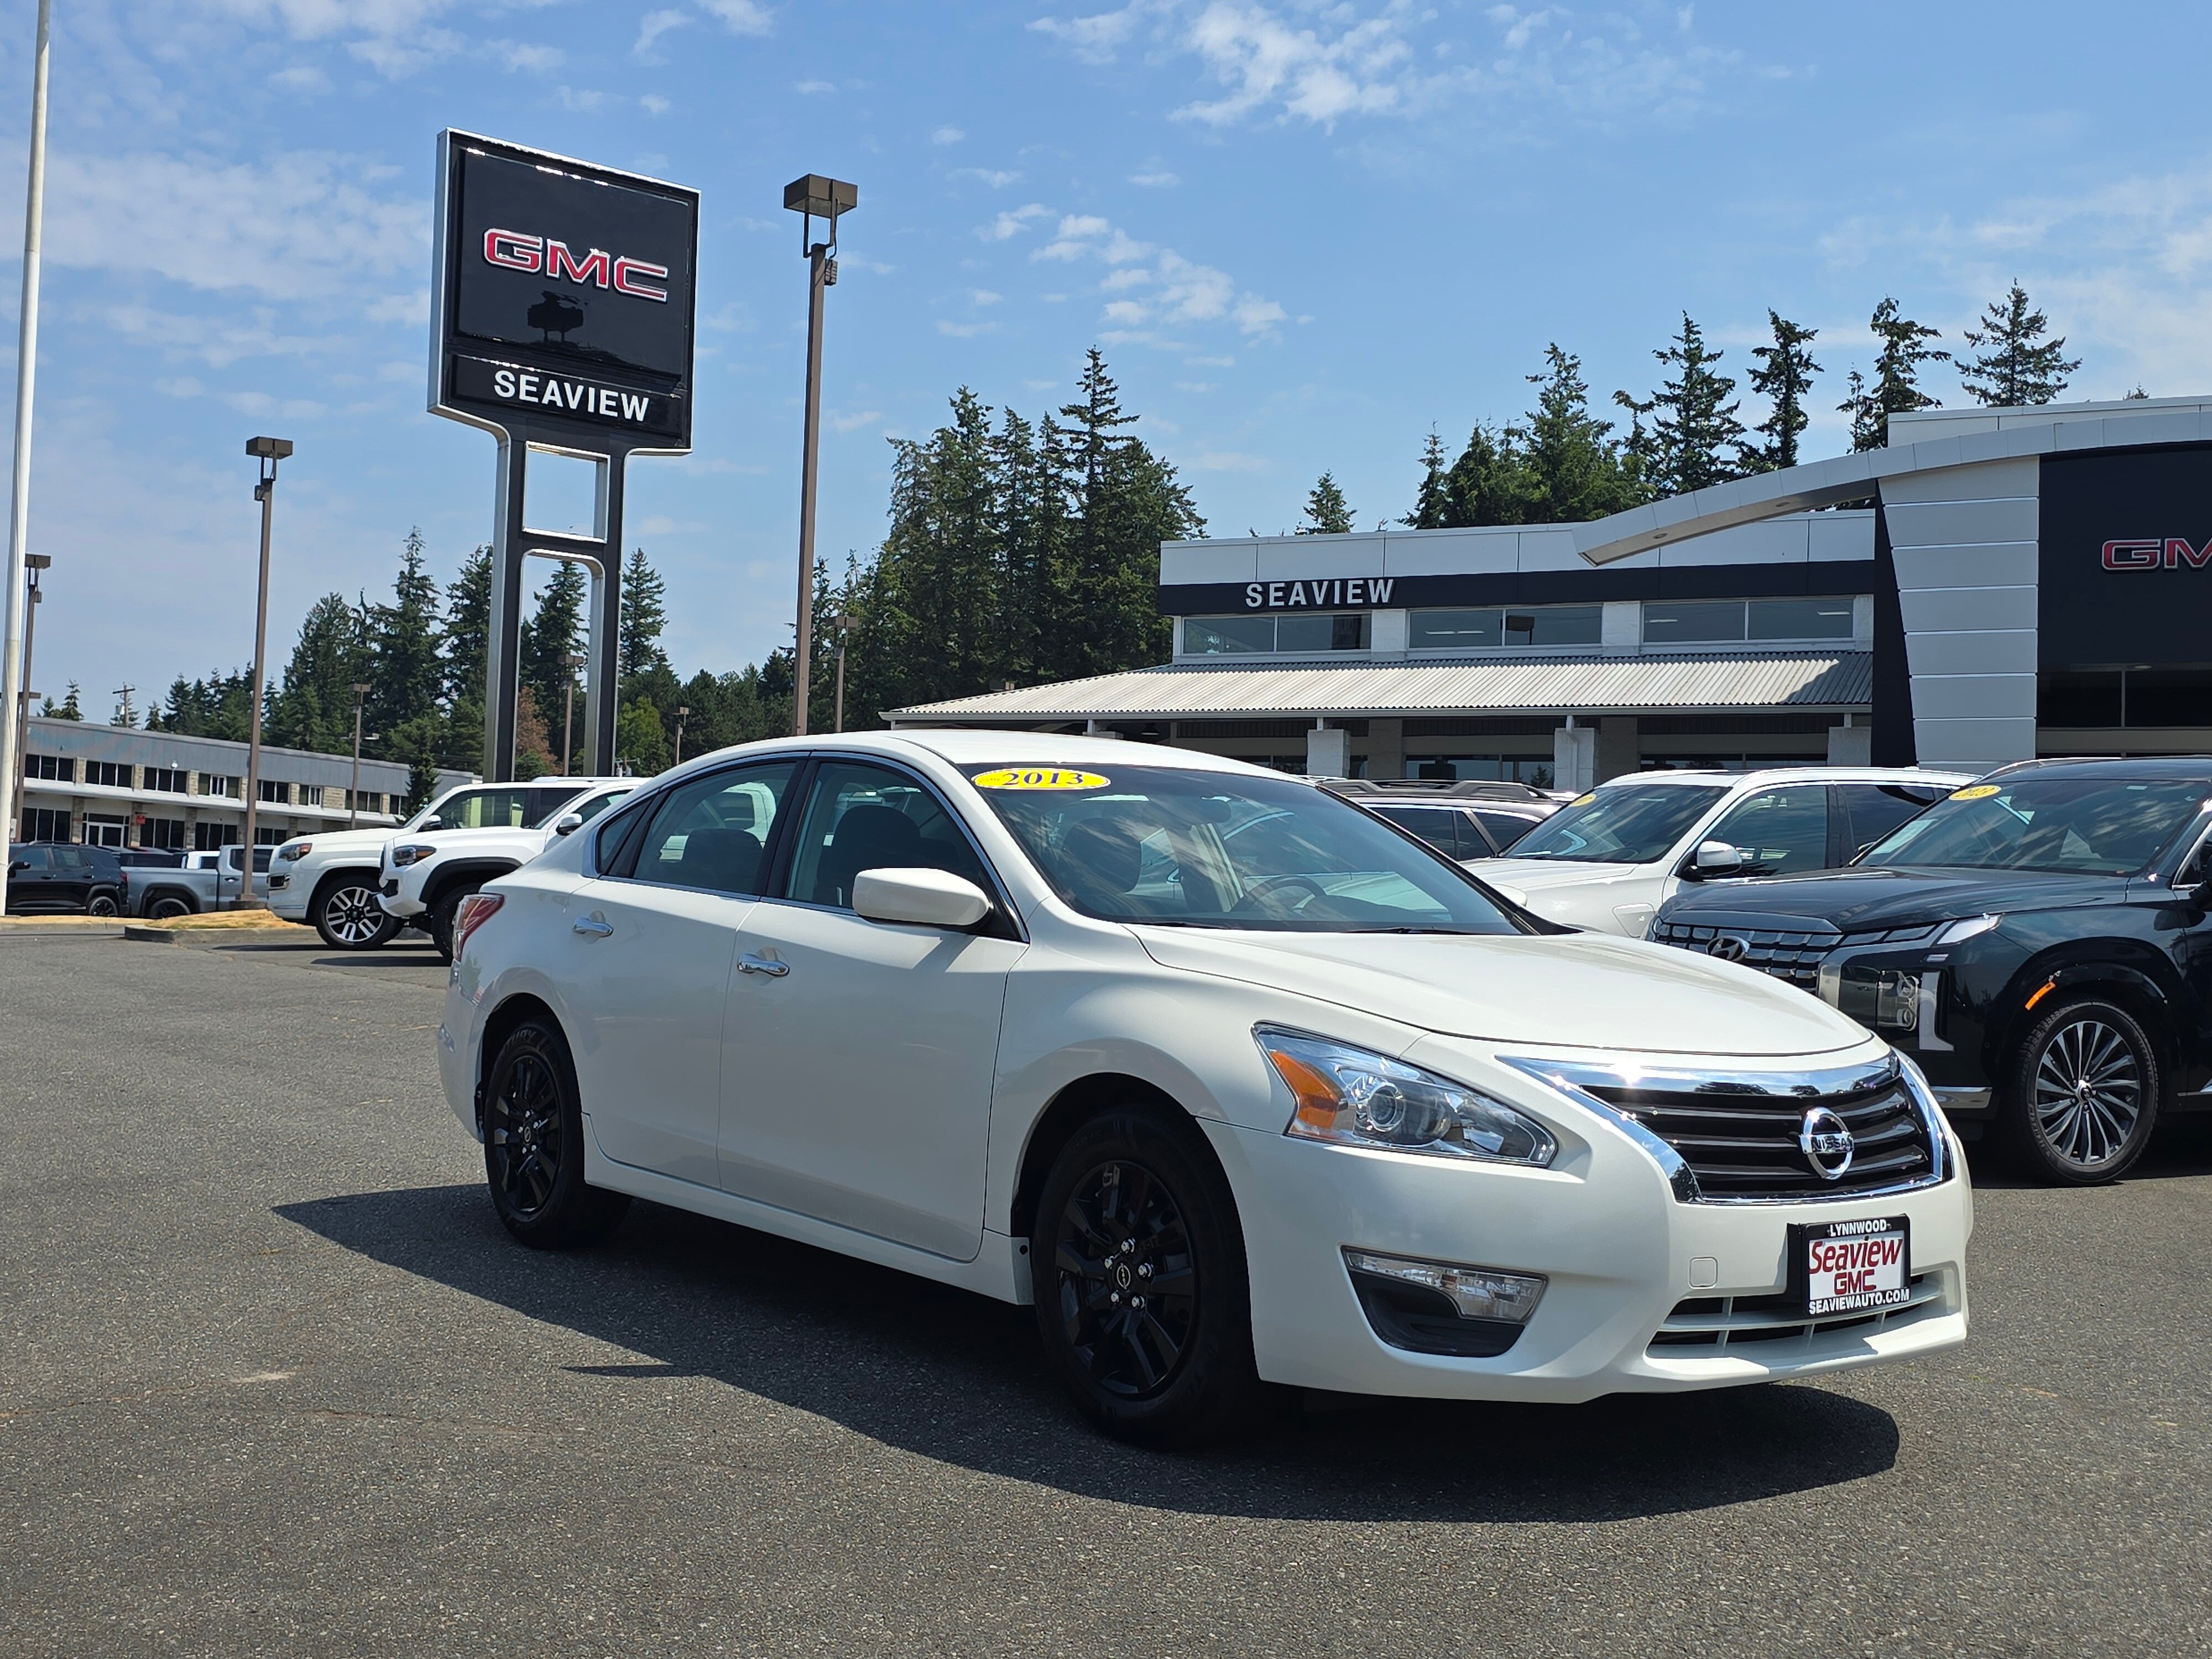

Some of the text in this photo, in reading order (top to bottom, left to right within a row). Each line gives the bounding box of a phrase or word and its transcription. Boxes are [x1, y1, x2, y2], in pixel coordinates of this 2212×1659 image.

[484, 228, 667, 302] GMC
[494, 370, 649, 421] SEAVIEW
[1245, 579, 1394, 607] SEAVIEW
[1002, 772, 1083, 785] 2013
[1830, 1219, 1887, 1237] LYNNWOOD
[1809, 1236, 1903, 1274] Seaview
[1834, 1269, 1876, 1295] GMC
[1809, 1288, 1909, 1314] SEAVIEWAUTO.COM
